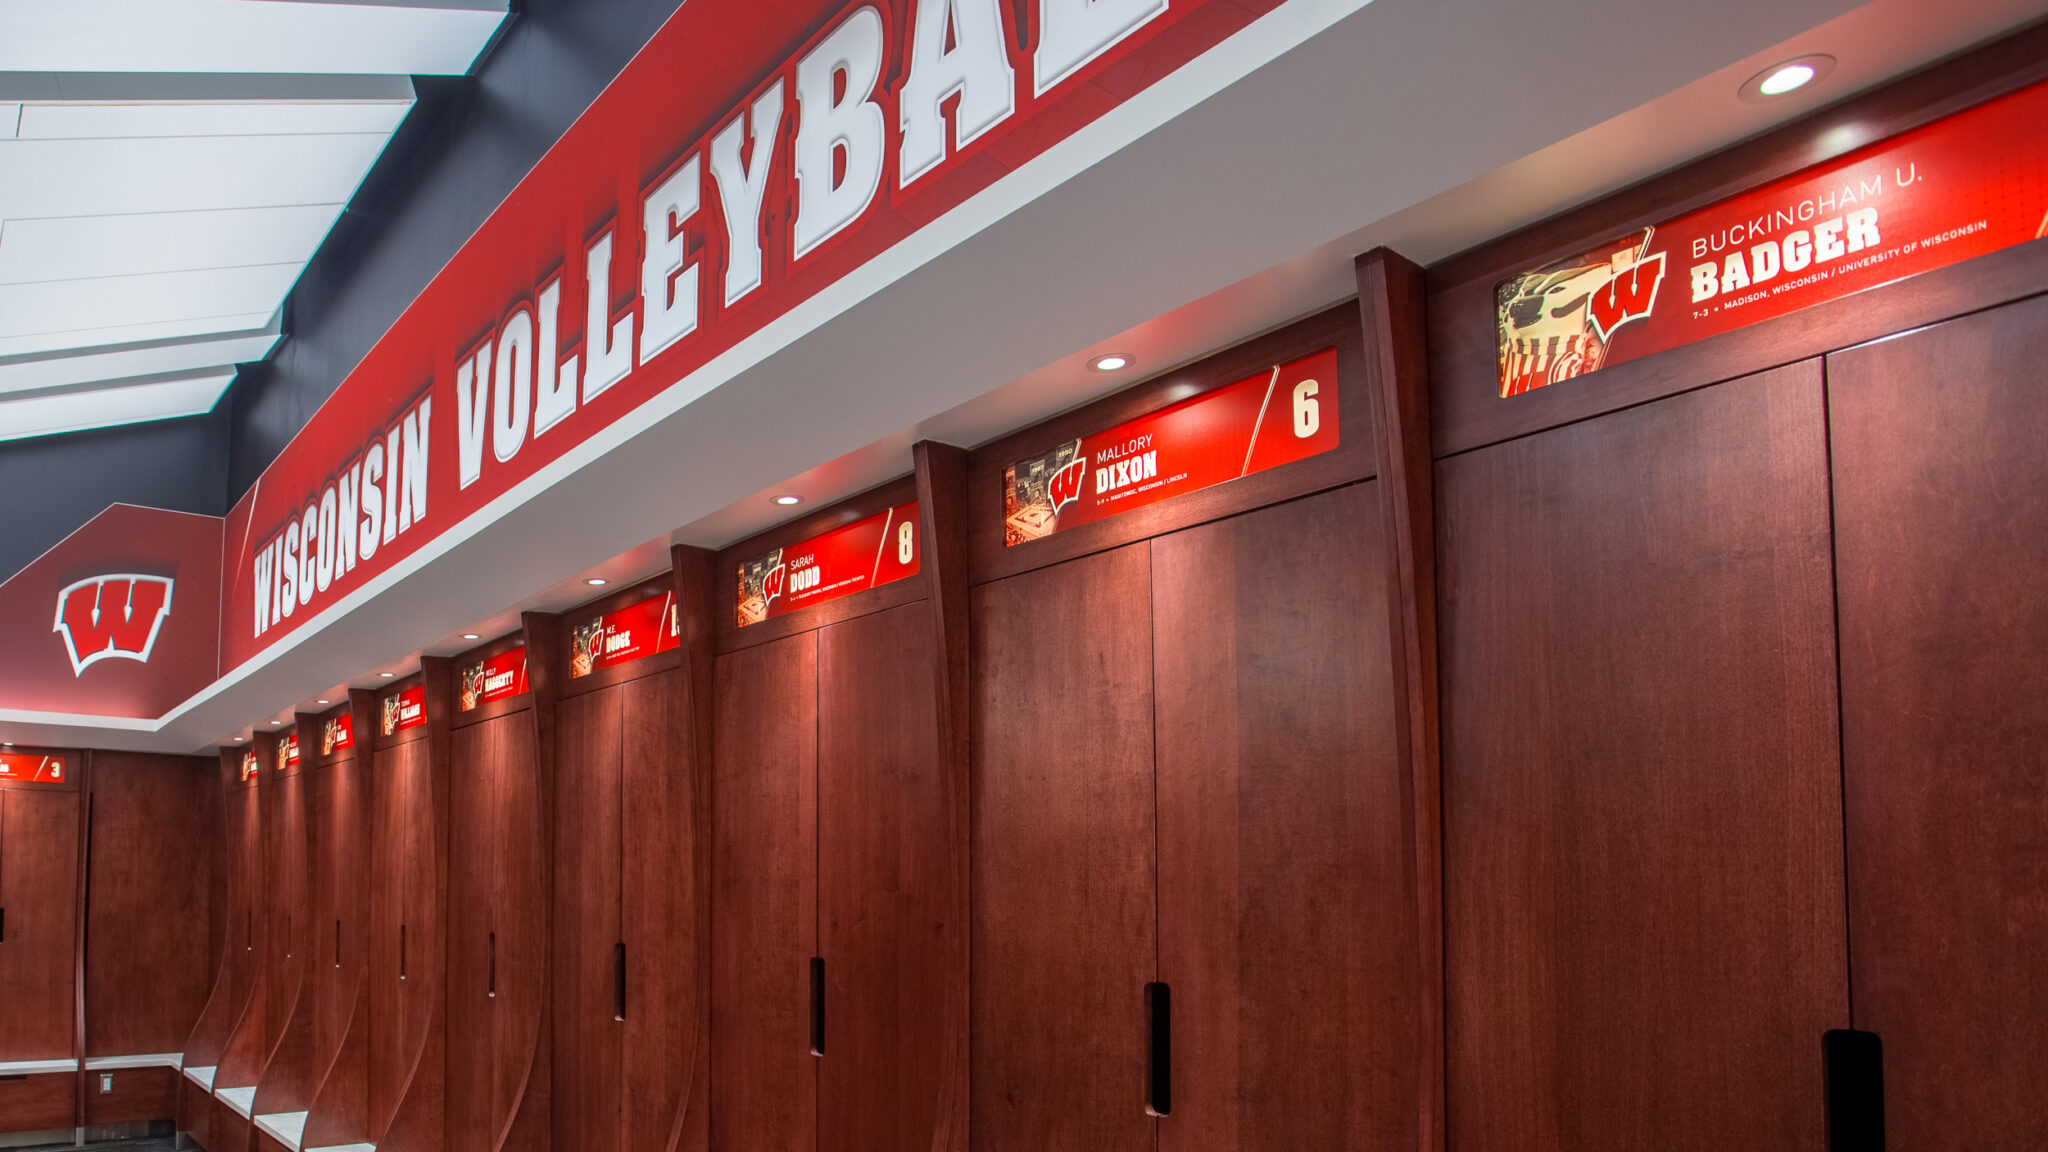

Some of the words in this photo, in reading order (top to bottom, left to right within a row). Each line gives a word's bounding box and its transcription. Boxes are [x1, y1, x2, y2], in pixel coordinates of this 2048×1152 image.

[1692, 175, 1882, 259] BUCKINGHAM
[1896, 163, 1922, 187] U.
[1690, 207, 1881, 303] BADGER
[1693, 309, 1709, 320] 7-3
[1724, 290, 1770, 310] MADISON,
[1772, 271, 1829, 296] WISCONSIN
[1839, 247, 1901, 275] UNIVERSITY
[1903, 241, 1918, 254] OF
[1920, 220, 1987, 248] WISCONSIN
[1293, 379, 1320, 439] 6
[1097, 433, 1153, 464] MALLORY
[1096, 450, 1157, 495] DIXON
[254, 395, 431, 638] WISCONSIN
[790, 553, 815, 570] SARAH
[898, 521, 913, 565] 8
[790, 565, 820, 593] DODD
[51, 761, 61, 778] 3
